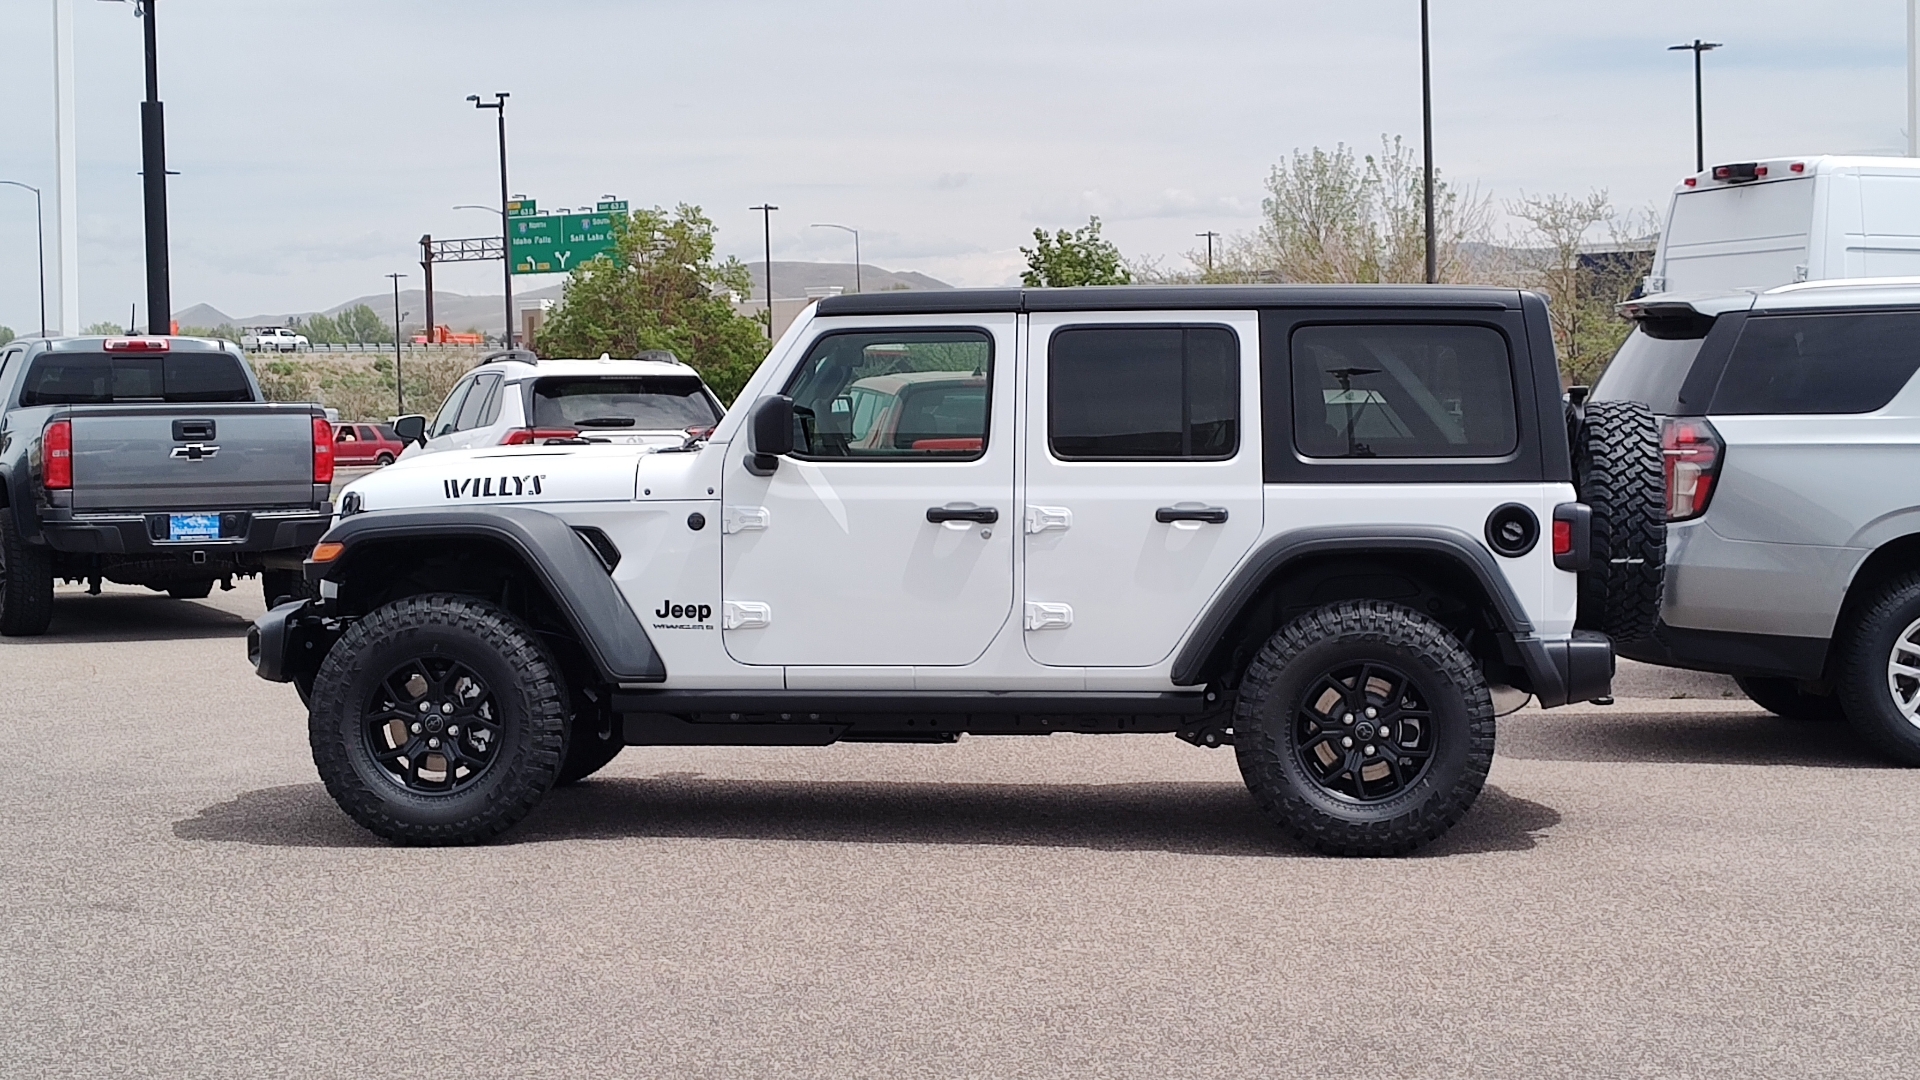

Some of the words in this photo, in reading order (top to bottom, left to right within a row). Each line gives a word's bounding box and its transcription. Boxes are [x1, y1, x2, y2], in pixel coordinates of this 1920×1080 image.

[513, 237, 532, 245] Idaho
[534, 236, 552, 244] Falls
[444, 475, 542, 499] WILLYS
[655, 599, 712, 623] Jeep
